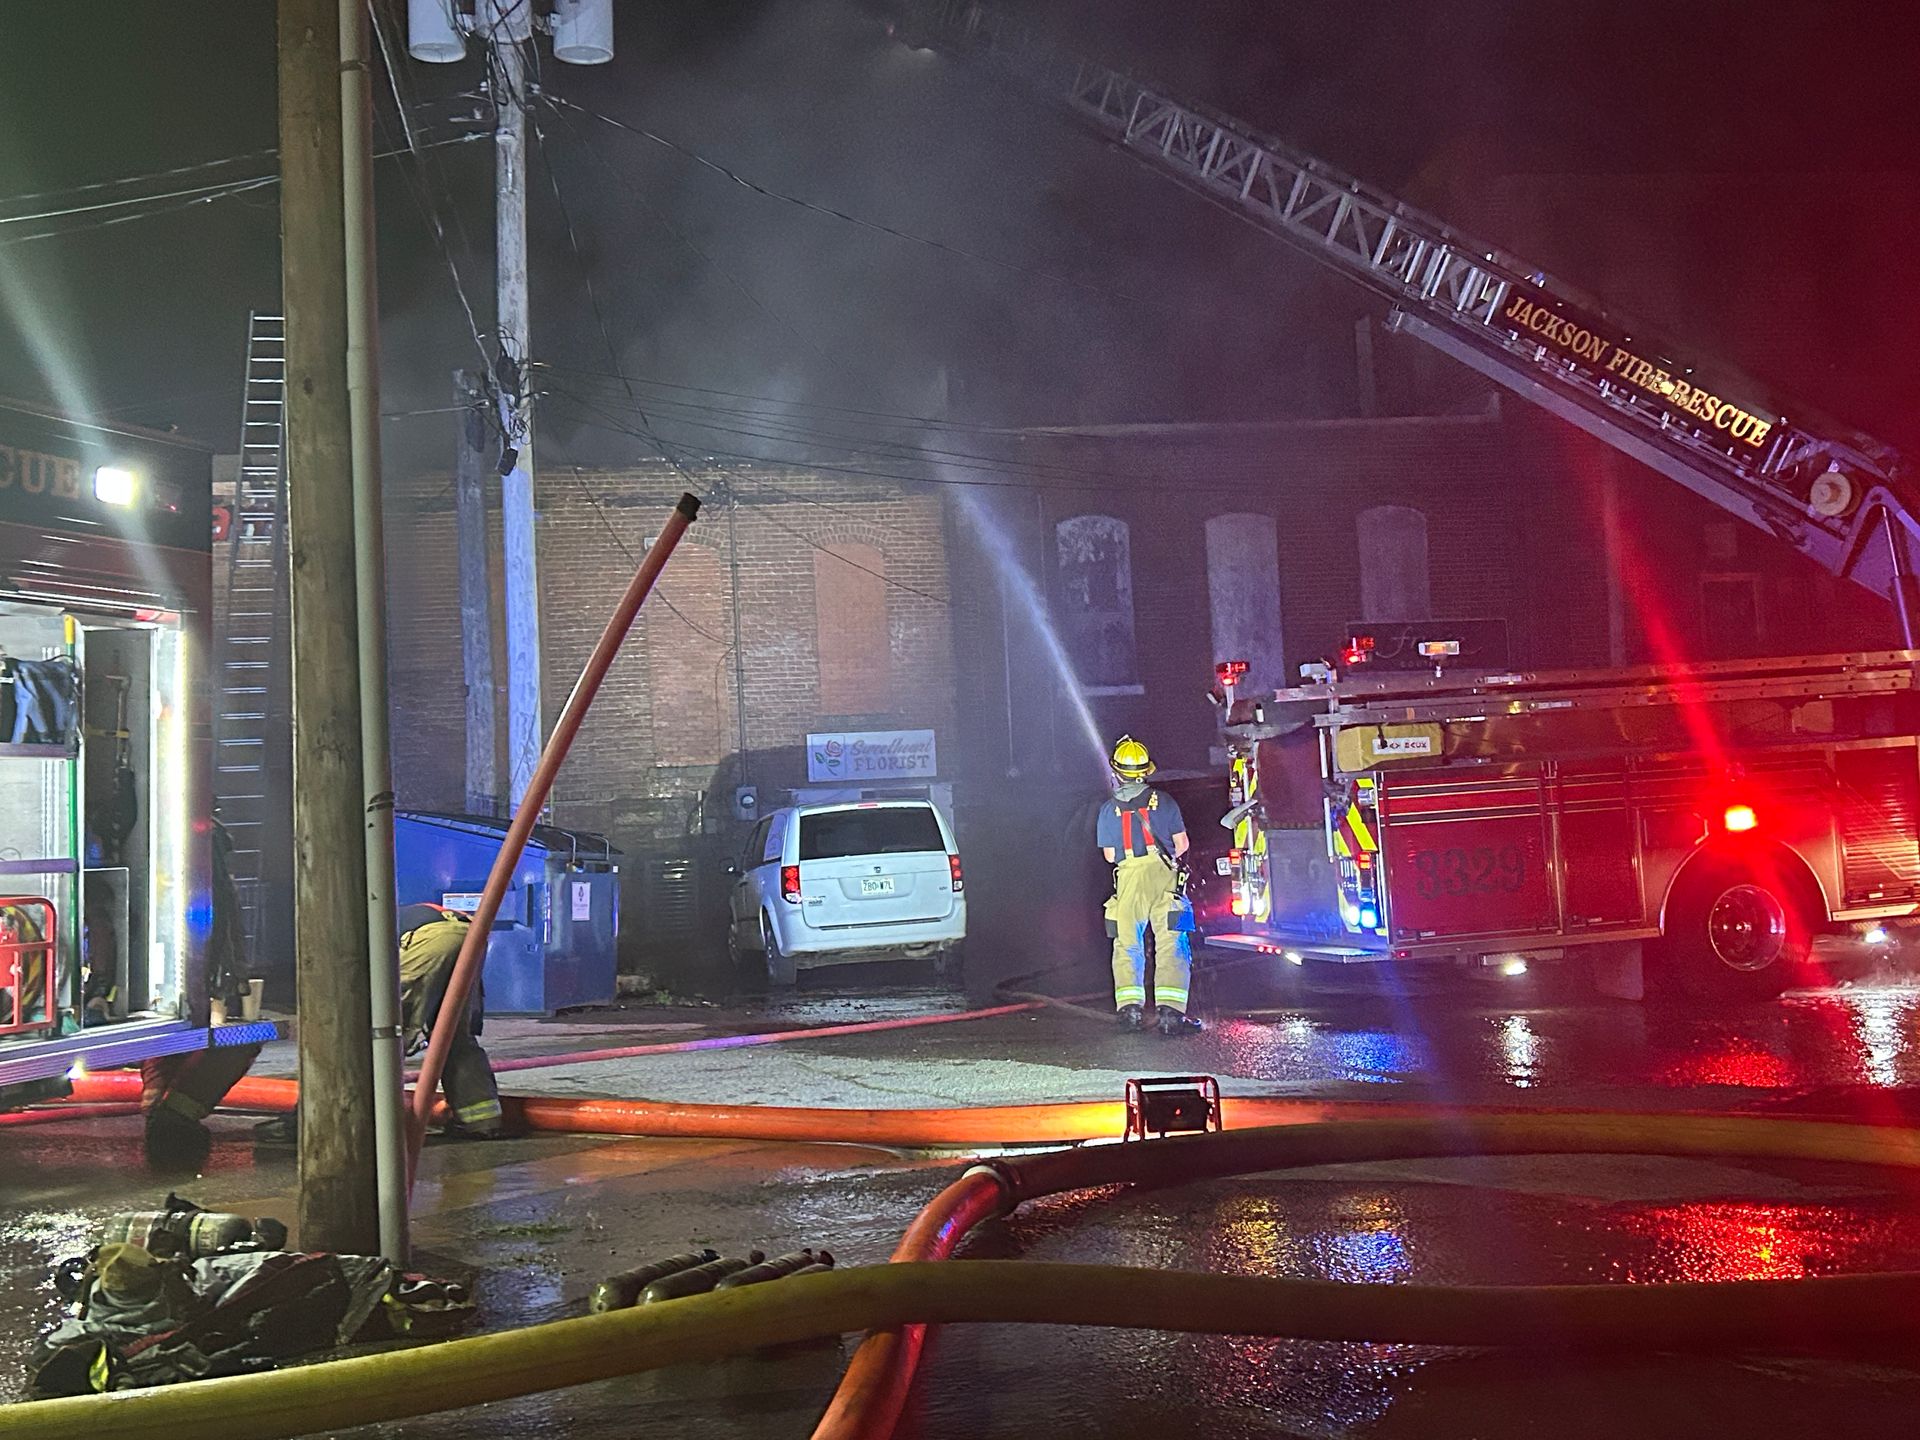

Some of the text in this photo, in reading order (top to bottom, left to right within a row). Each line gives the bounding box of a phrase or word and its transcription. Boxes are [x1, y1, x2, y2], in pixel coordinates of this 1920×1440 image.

[1506, 297, 1772, 448] JACKSON FIRE RESCUE
[850, 737, 933, 757] Sweetheart
[854, 755, 930, 771] FLORIST
